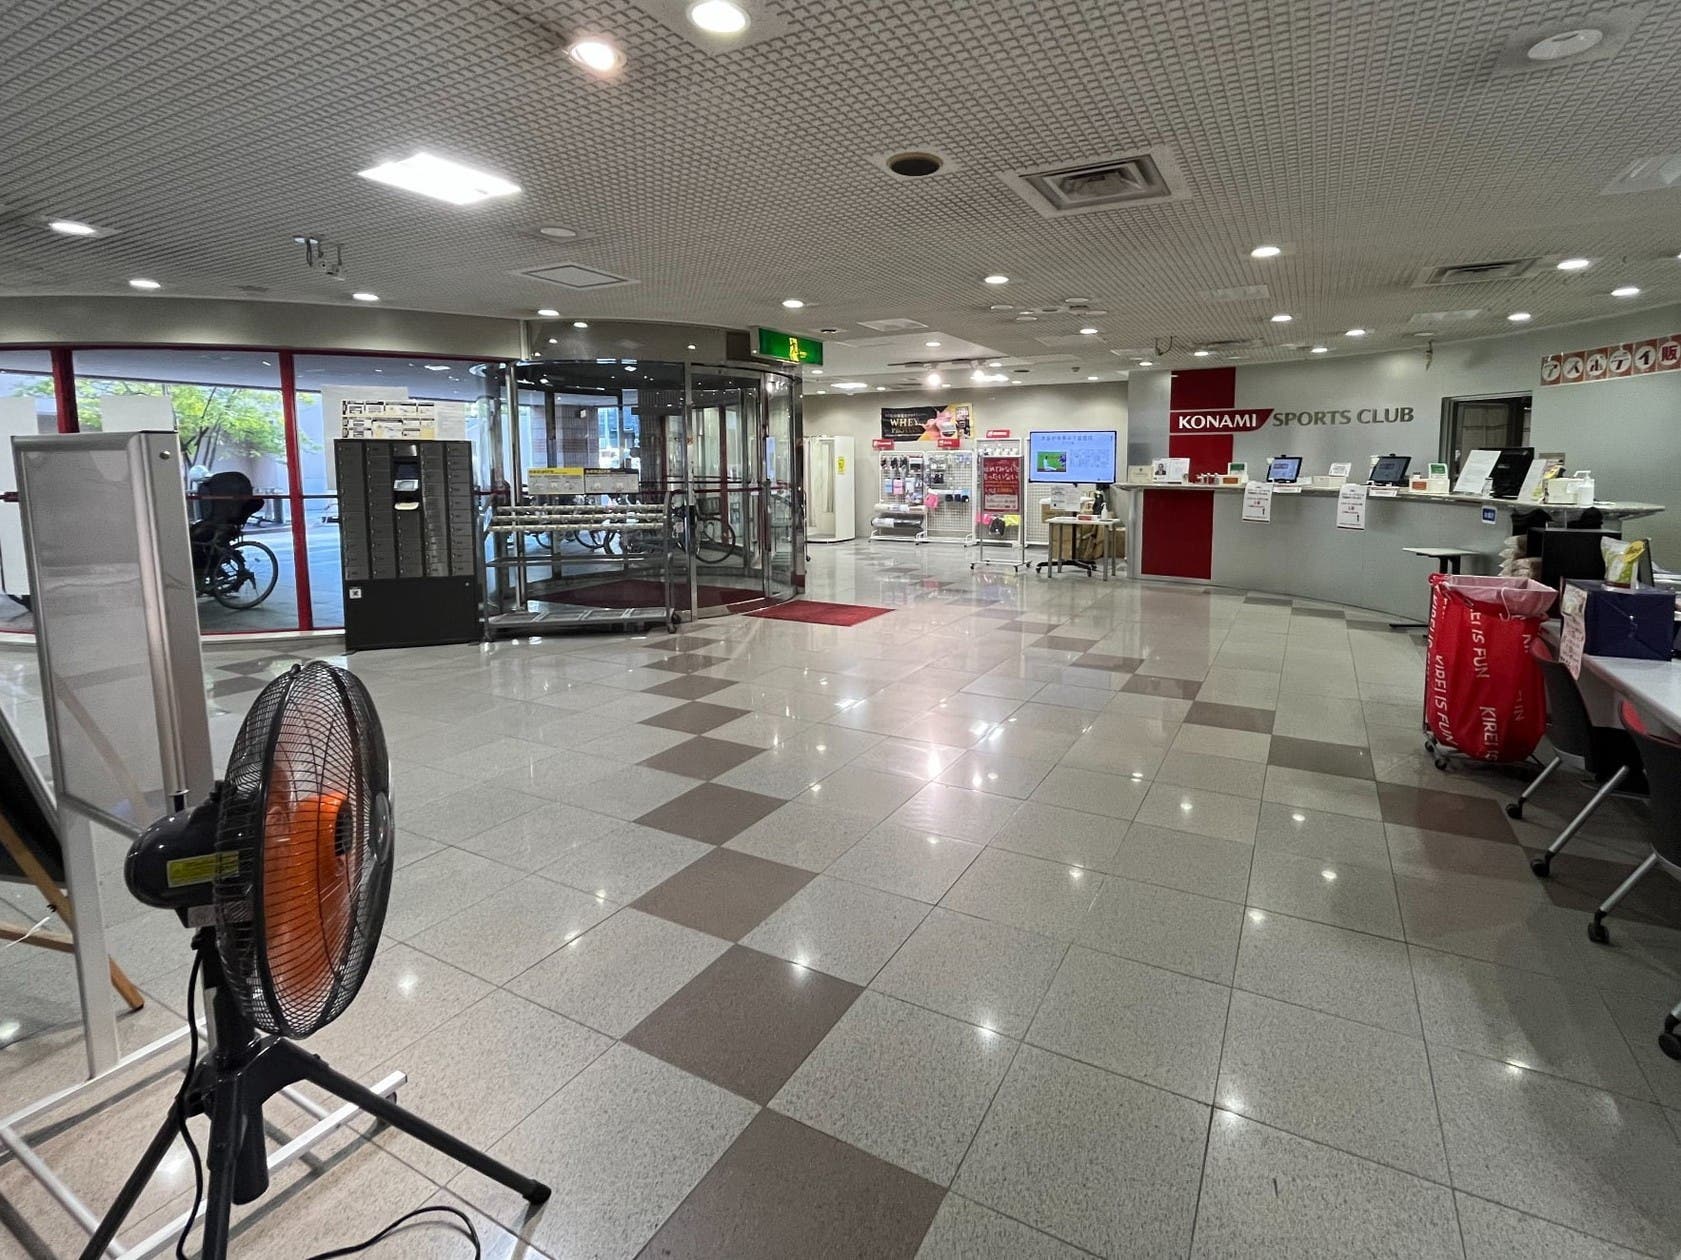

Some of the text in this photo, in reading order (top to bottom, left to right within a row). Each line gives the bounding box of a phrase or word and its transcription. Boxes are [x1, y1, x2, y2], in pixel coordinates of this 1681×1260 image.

[890, 418, 920, 427] WHEY
[1178, 407, 1414, 430] KONAMI SPORTS CLUB
[1472, 628, 1485, 645] IS
[1473, 647, 1490, 678] FUN
[1435, 695, 1448, 711] IS
[1479, 706, 1499, 746] KIREI
